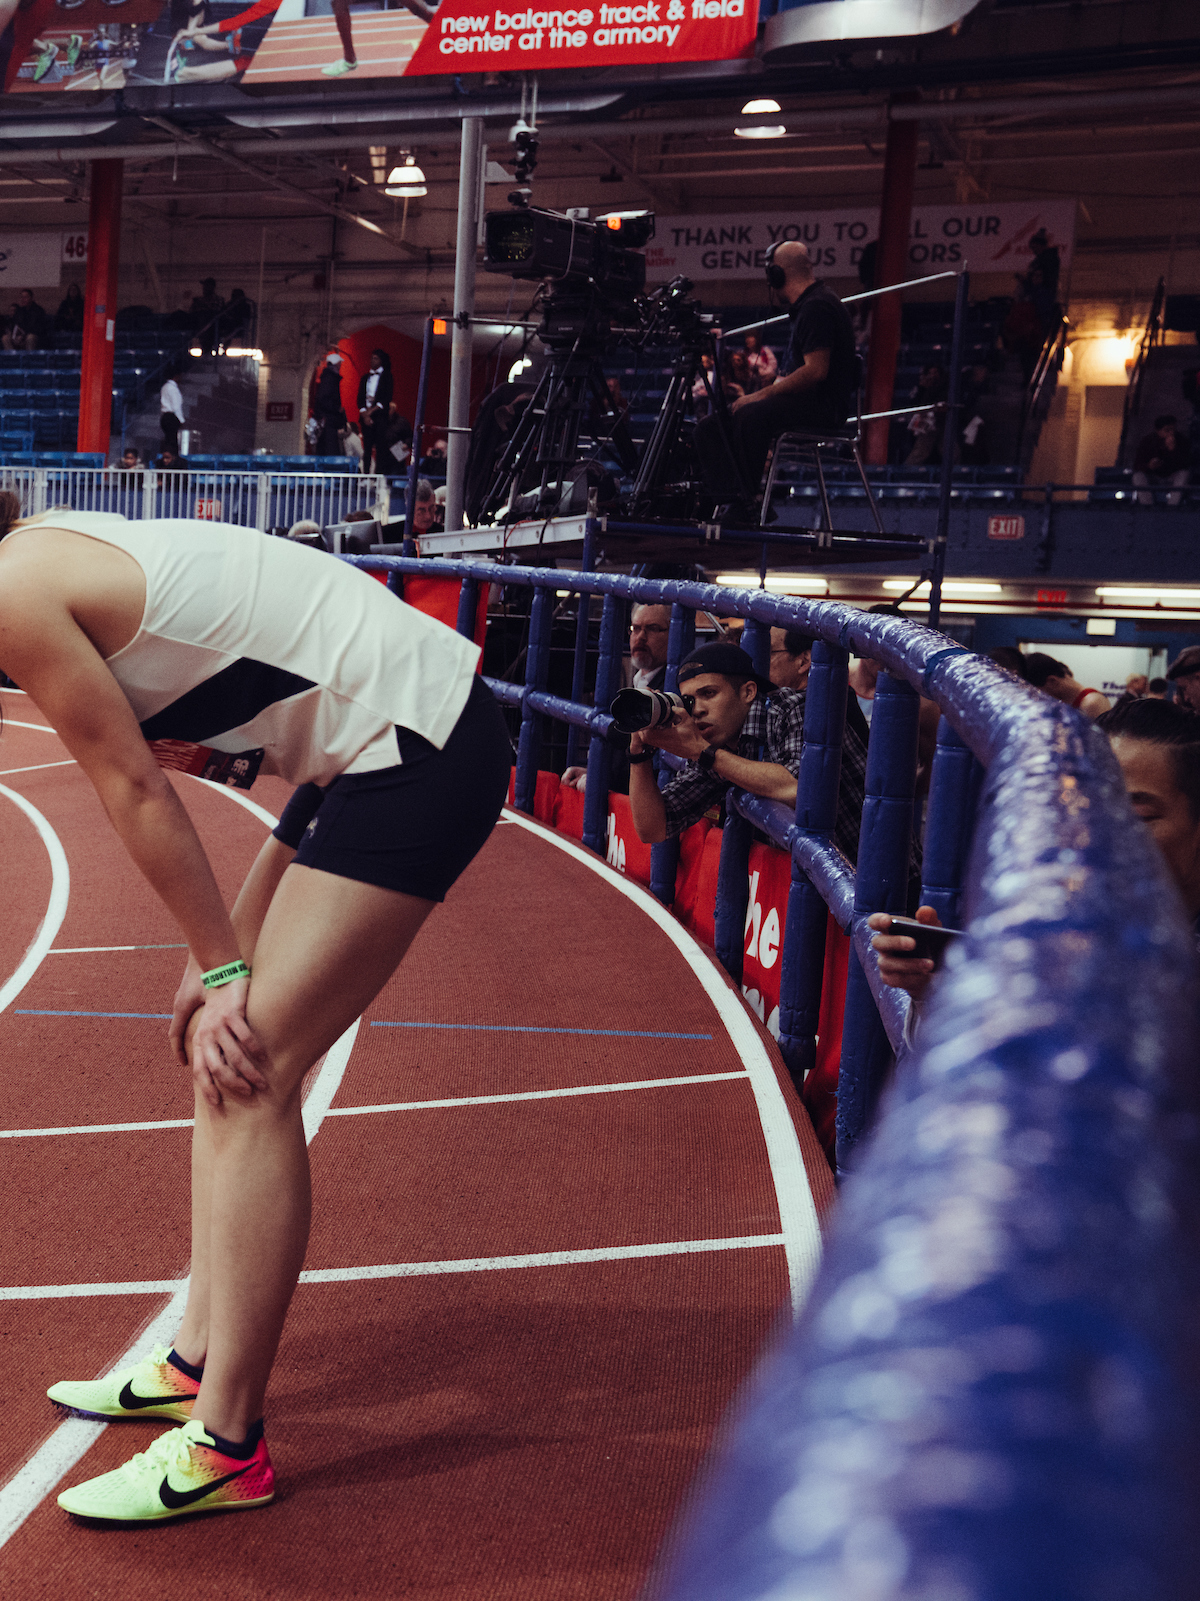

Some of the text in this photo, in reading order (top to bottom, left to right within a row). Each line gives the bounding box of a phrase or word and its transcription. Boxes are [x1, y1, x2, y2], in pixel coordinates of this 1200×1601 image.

[440, 0, 745, 34] new balance track & field
[438, 24, 681, 54] center at the armory
[670, 226, 752, 247] THANK
[766, 223, 820, 243] YOU
[833, 222, 868, 241] TO
[943, 215, 1000, 238] OUR
[65, 236, 88, 258] 46
[701, 243, 962, 269] GENEUS DORS
[990, 519, 1017, 535] EXIT
[744, 869, 780, 969] he
